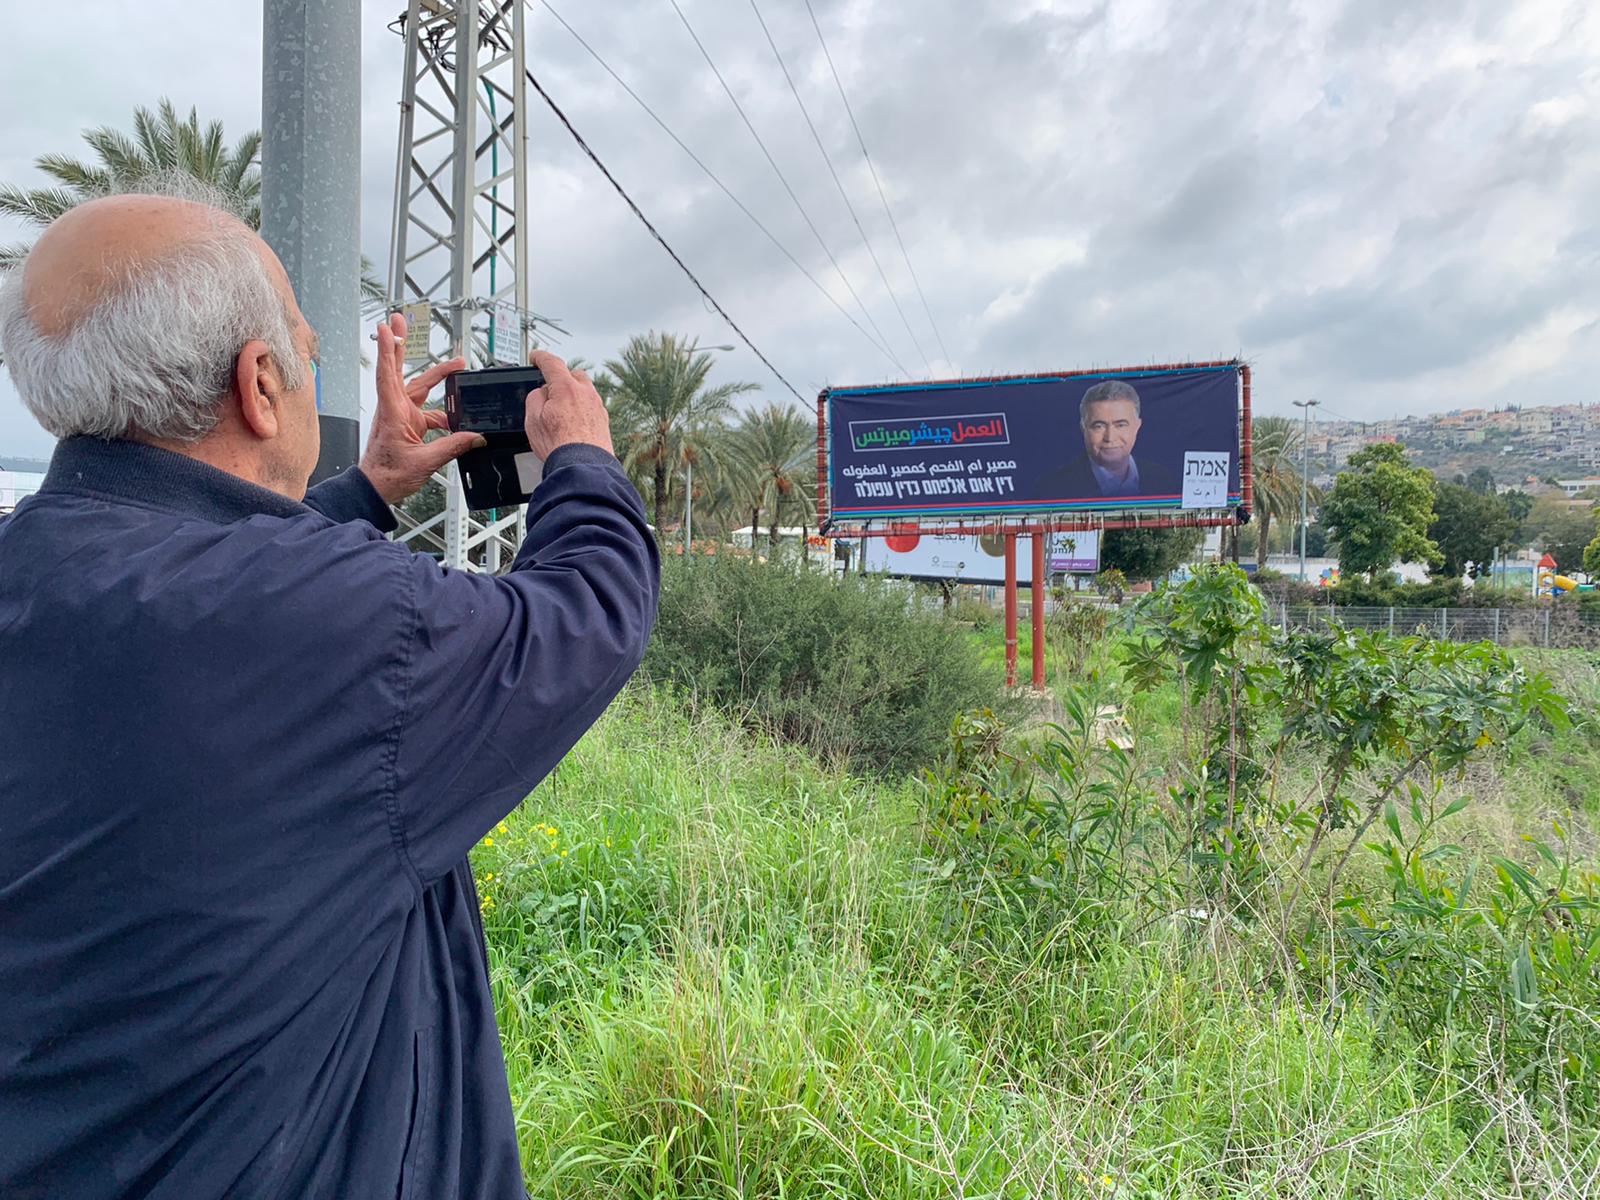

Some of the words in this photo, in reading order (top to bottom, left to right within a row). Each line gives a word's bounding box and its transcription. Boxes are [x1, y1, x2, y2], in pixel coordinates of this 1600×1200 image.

[856, 427, 911, 448] ميرتس
[952, 420, 1003, 443] العمل
[891, 462, 926, 478] كمصير
[929, 460, 964, 477] الفحم
[986, 460, 1017, 474] مصير
[1185, 459, 1227, 477] אמת
[854, 480, 894, 498] עפולה
[894, 479, 921, 499] כדין
[968, 477, 994, 493] אום
[995, 476, 1015, 495] דין
